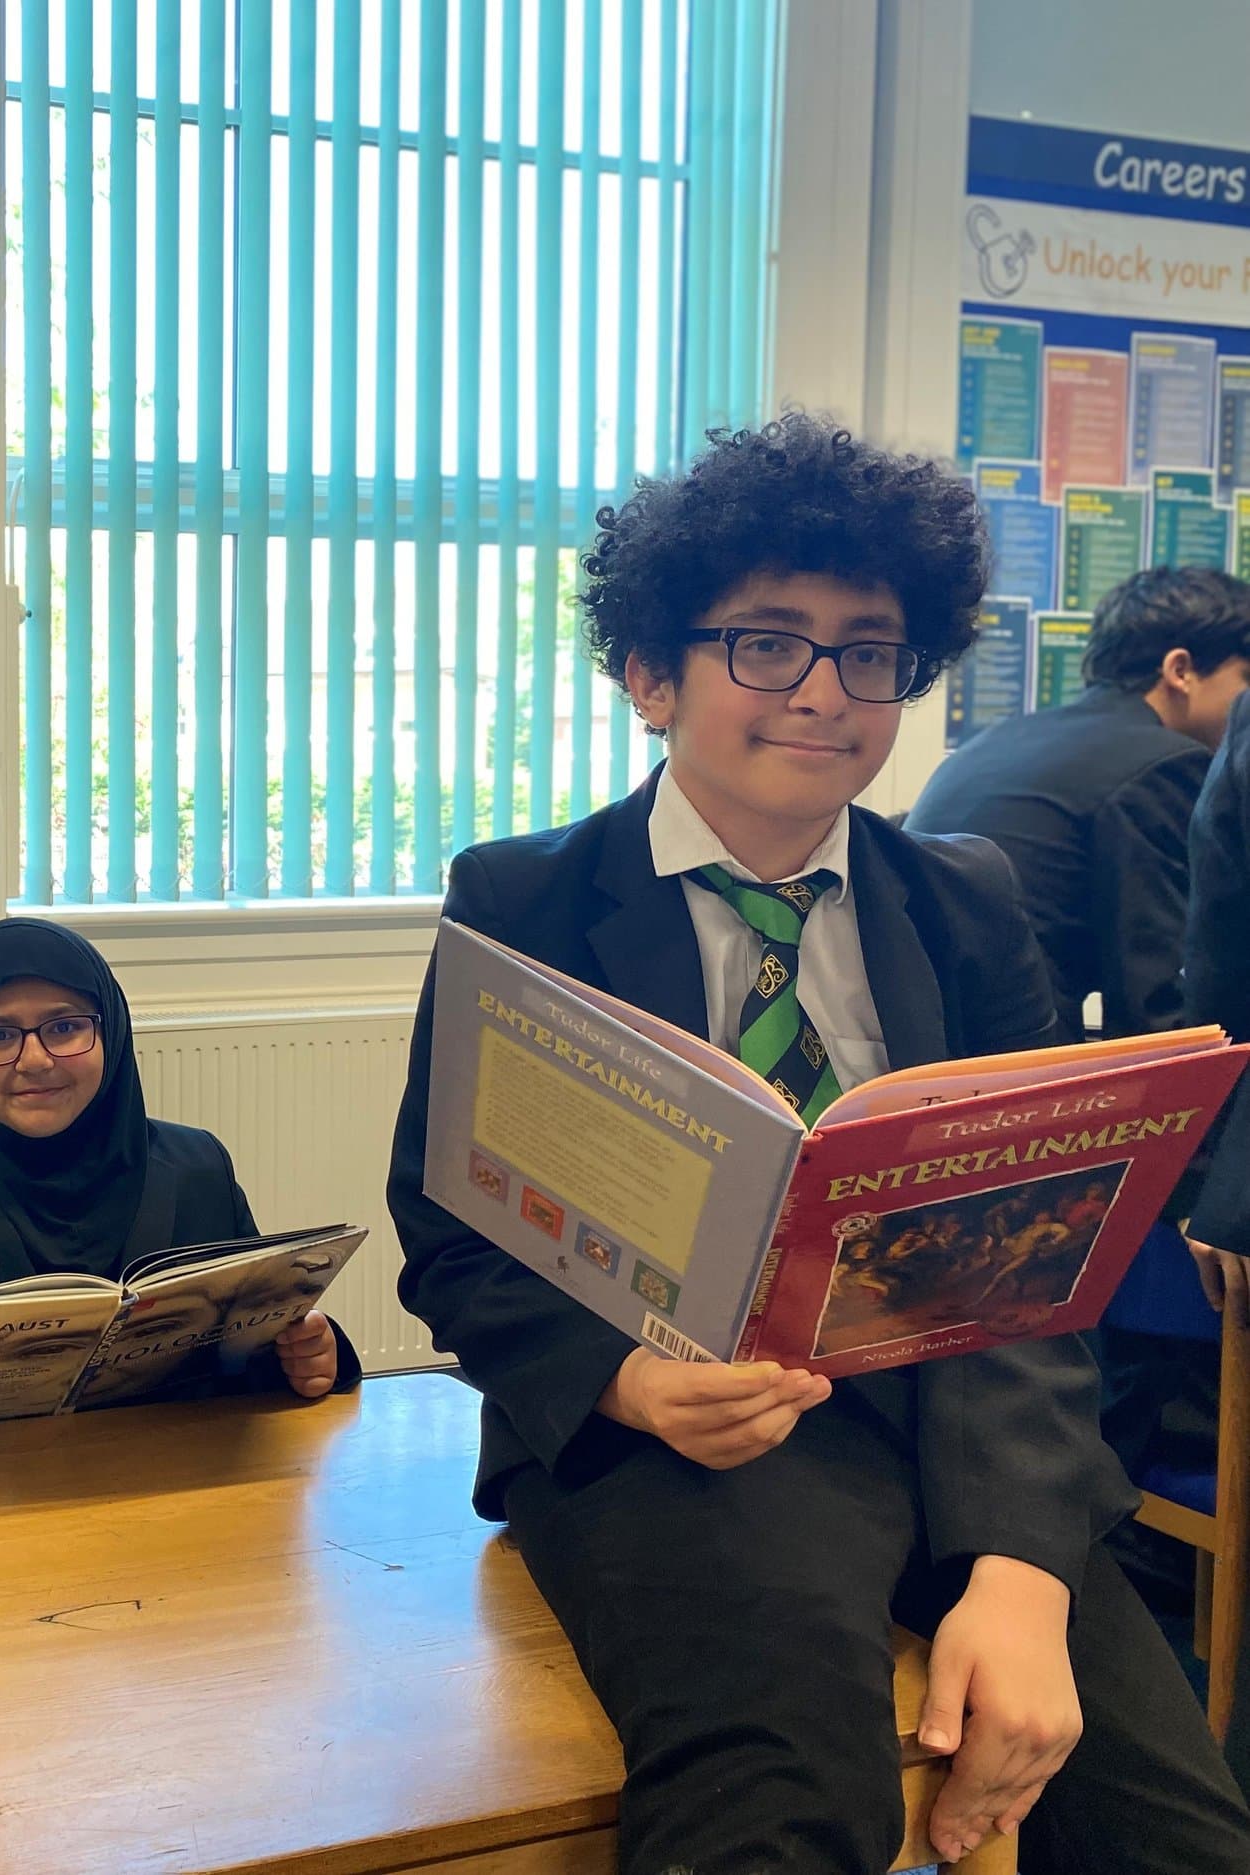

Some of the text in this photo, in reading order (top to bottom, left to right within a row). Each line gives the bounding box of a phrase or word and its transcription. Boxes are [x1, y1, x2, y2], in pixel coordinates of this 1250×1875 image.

[1093, 141, 1247, 203] Careers
[1042, 236, 1154, 283] Unlock
[1160, 257, 1233, 297] your
[476, 986, 735, 1155] ENTERTAINMENT
[542, 1000, 664, 1082] Tudor Life
[937, 1089, 1119, 1141] Tudor Life
[825, 1105, 1204, 1203] ENTERTAINMENT
[100, 1301, 314, 1371] HOLOCAUST
[861, 1333, 975, 1365] Nicola Barber
